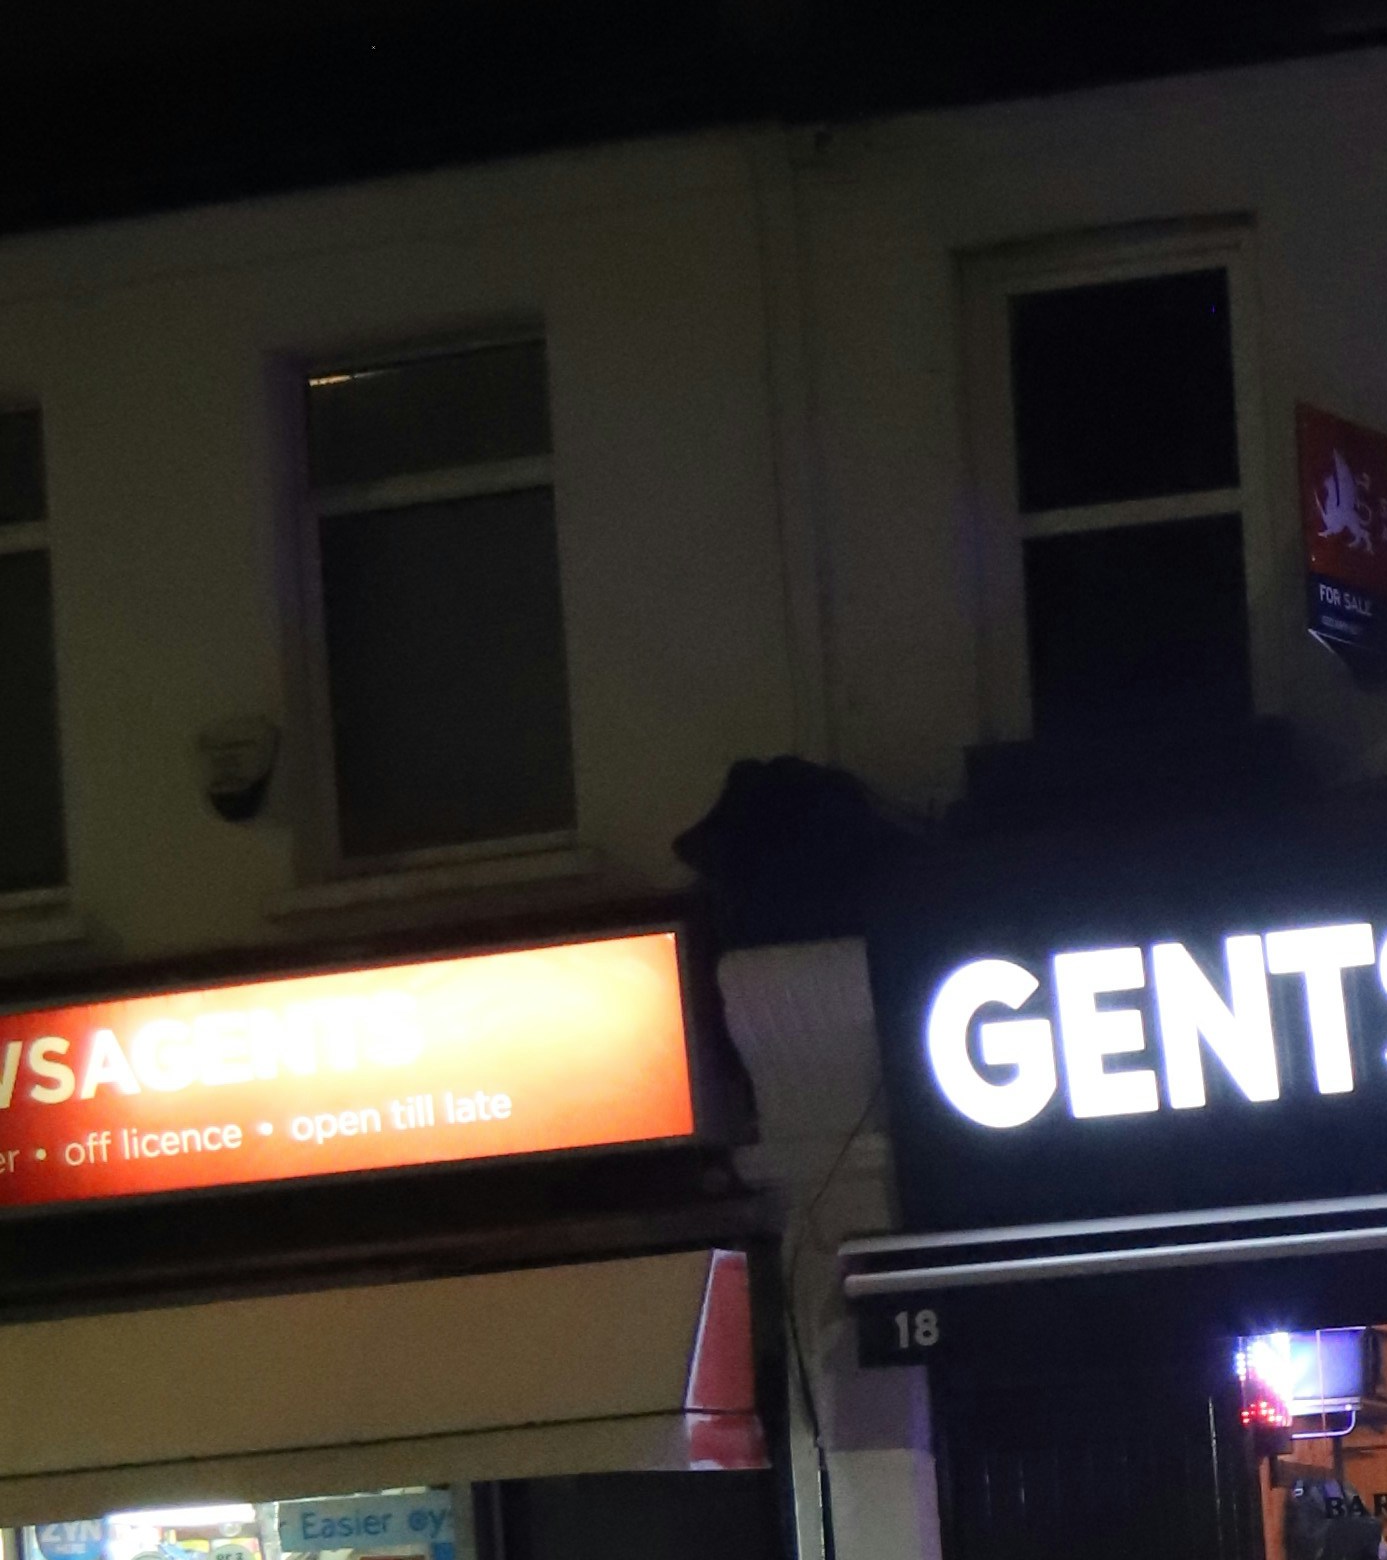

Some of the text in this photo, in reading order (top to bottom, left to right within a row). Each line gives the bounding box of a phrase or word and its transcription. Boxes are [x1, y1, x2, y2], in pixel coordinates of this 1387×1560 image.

[1319, 583, 1373, 617] FOR SALE
[65, 1130, 111, 1166] off
[122, 1122, 244, 1160] licence
[290, 1105, 383, 1145] open
[390, 1092, 434, 1132] till
[446, 1089, 513, 1125] late
[894, 1309, 940, 1349] 18
[302, 1510, 393, 1540] Easier
